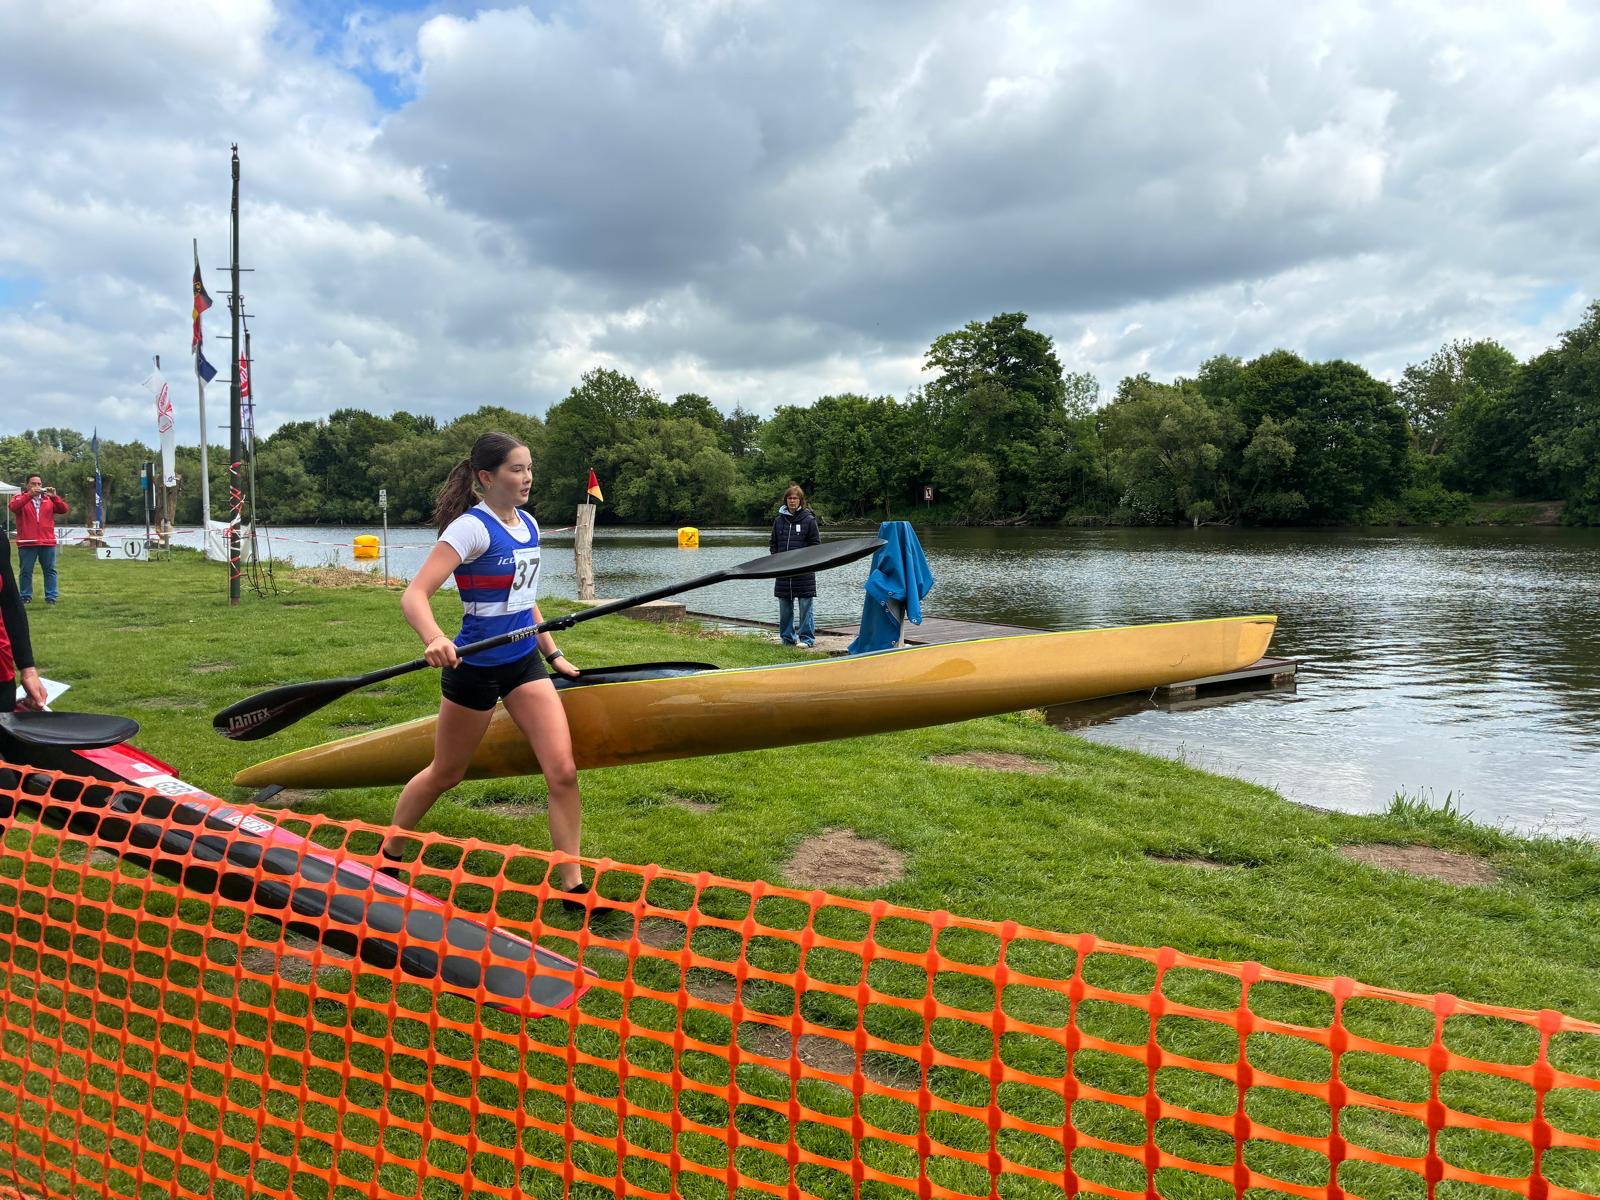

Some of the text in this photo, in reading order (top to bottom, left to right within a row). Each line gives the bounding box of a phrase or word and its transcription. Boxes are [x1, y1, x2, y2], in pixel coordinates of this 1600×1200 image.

[105, 549, 112, 558] 2
[129, 541, 135, 555] 1
[512, 557, 540, 591] 37
